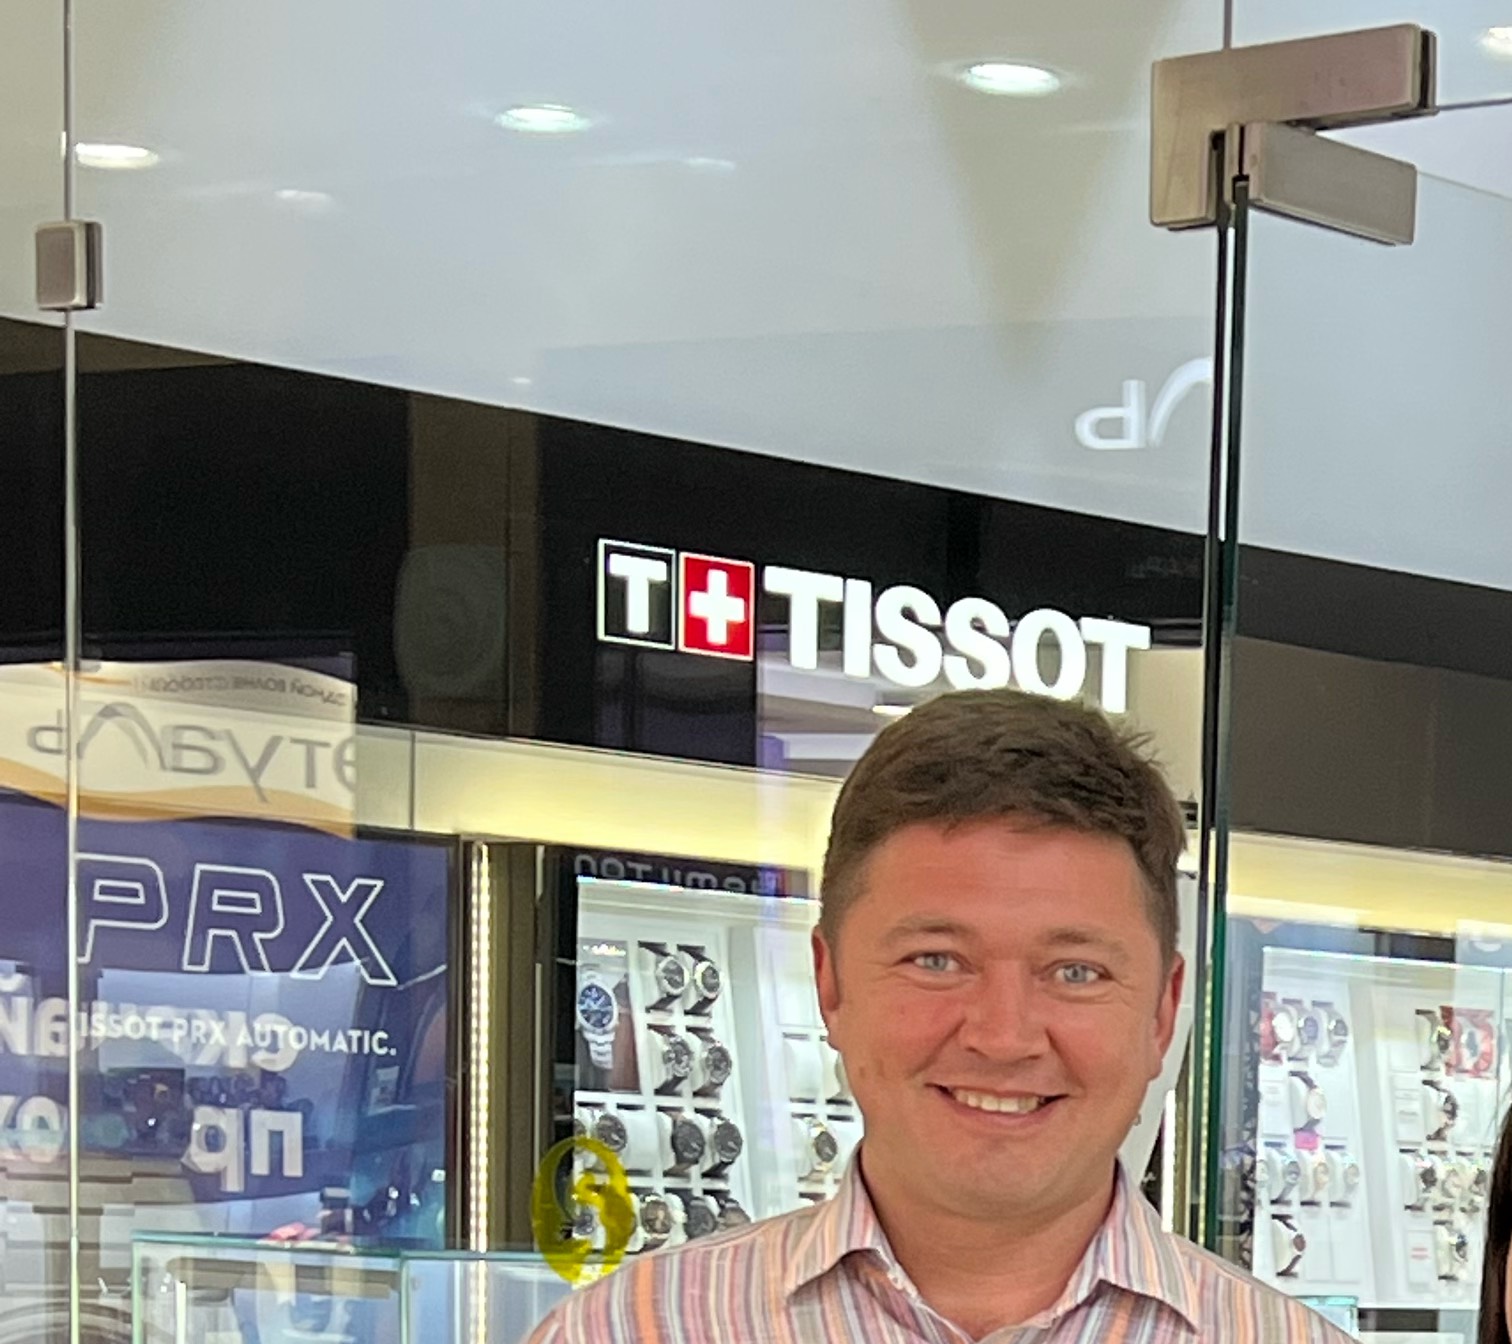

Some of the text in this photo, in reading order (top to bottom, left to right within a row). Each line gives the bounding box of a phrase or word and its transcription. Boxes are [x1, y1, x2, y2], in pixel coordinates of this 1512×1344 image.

[765, 565, 1151, 713] TISSOT
[75, 852, 398, 988] PRX
[72, 1016, 398, 1056] ISSOT PRX AUTOMATIC.
